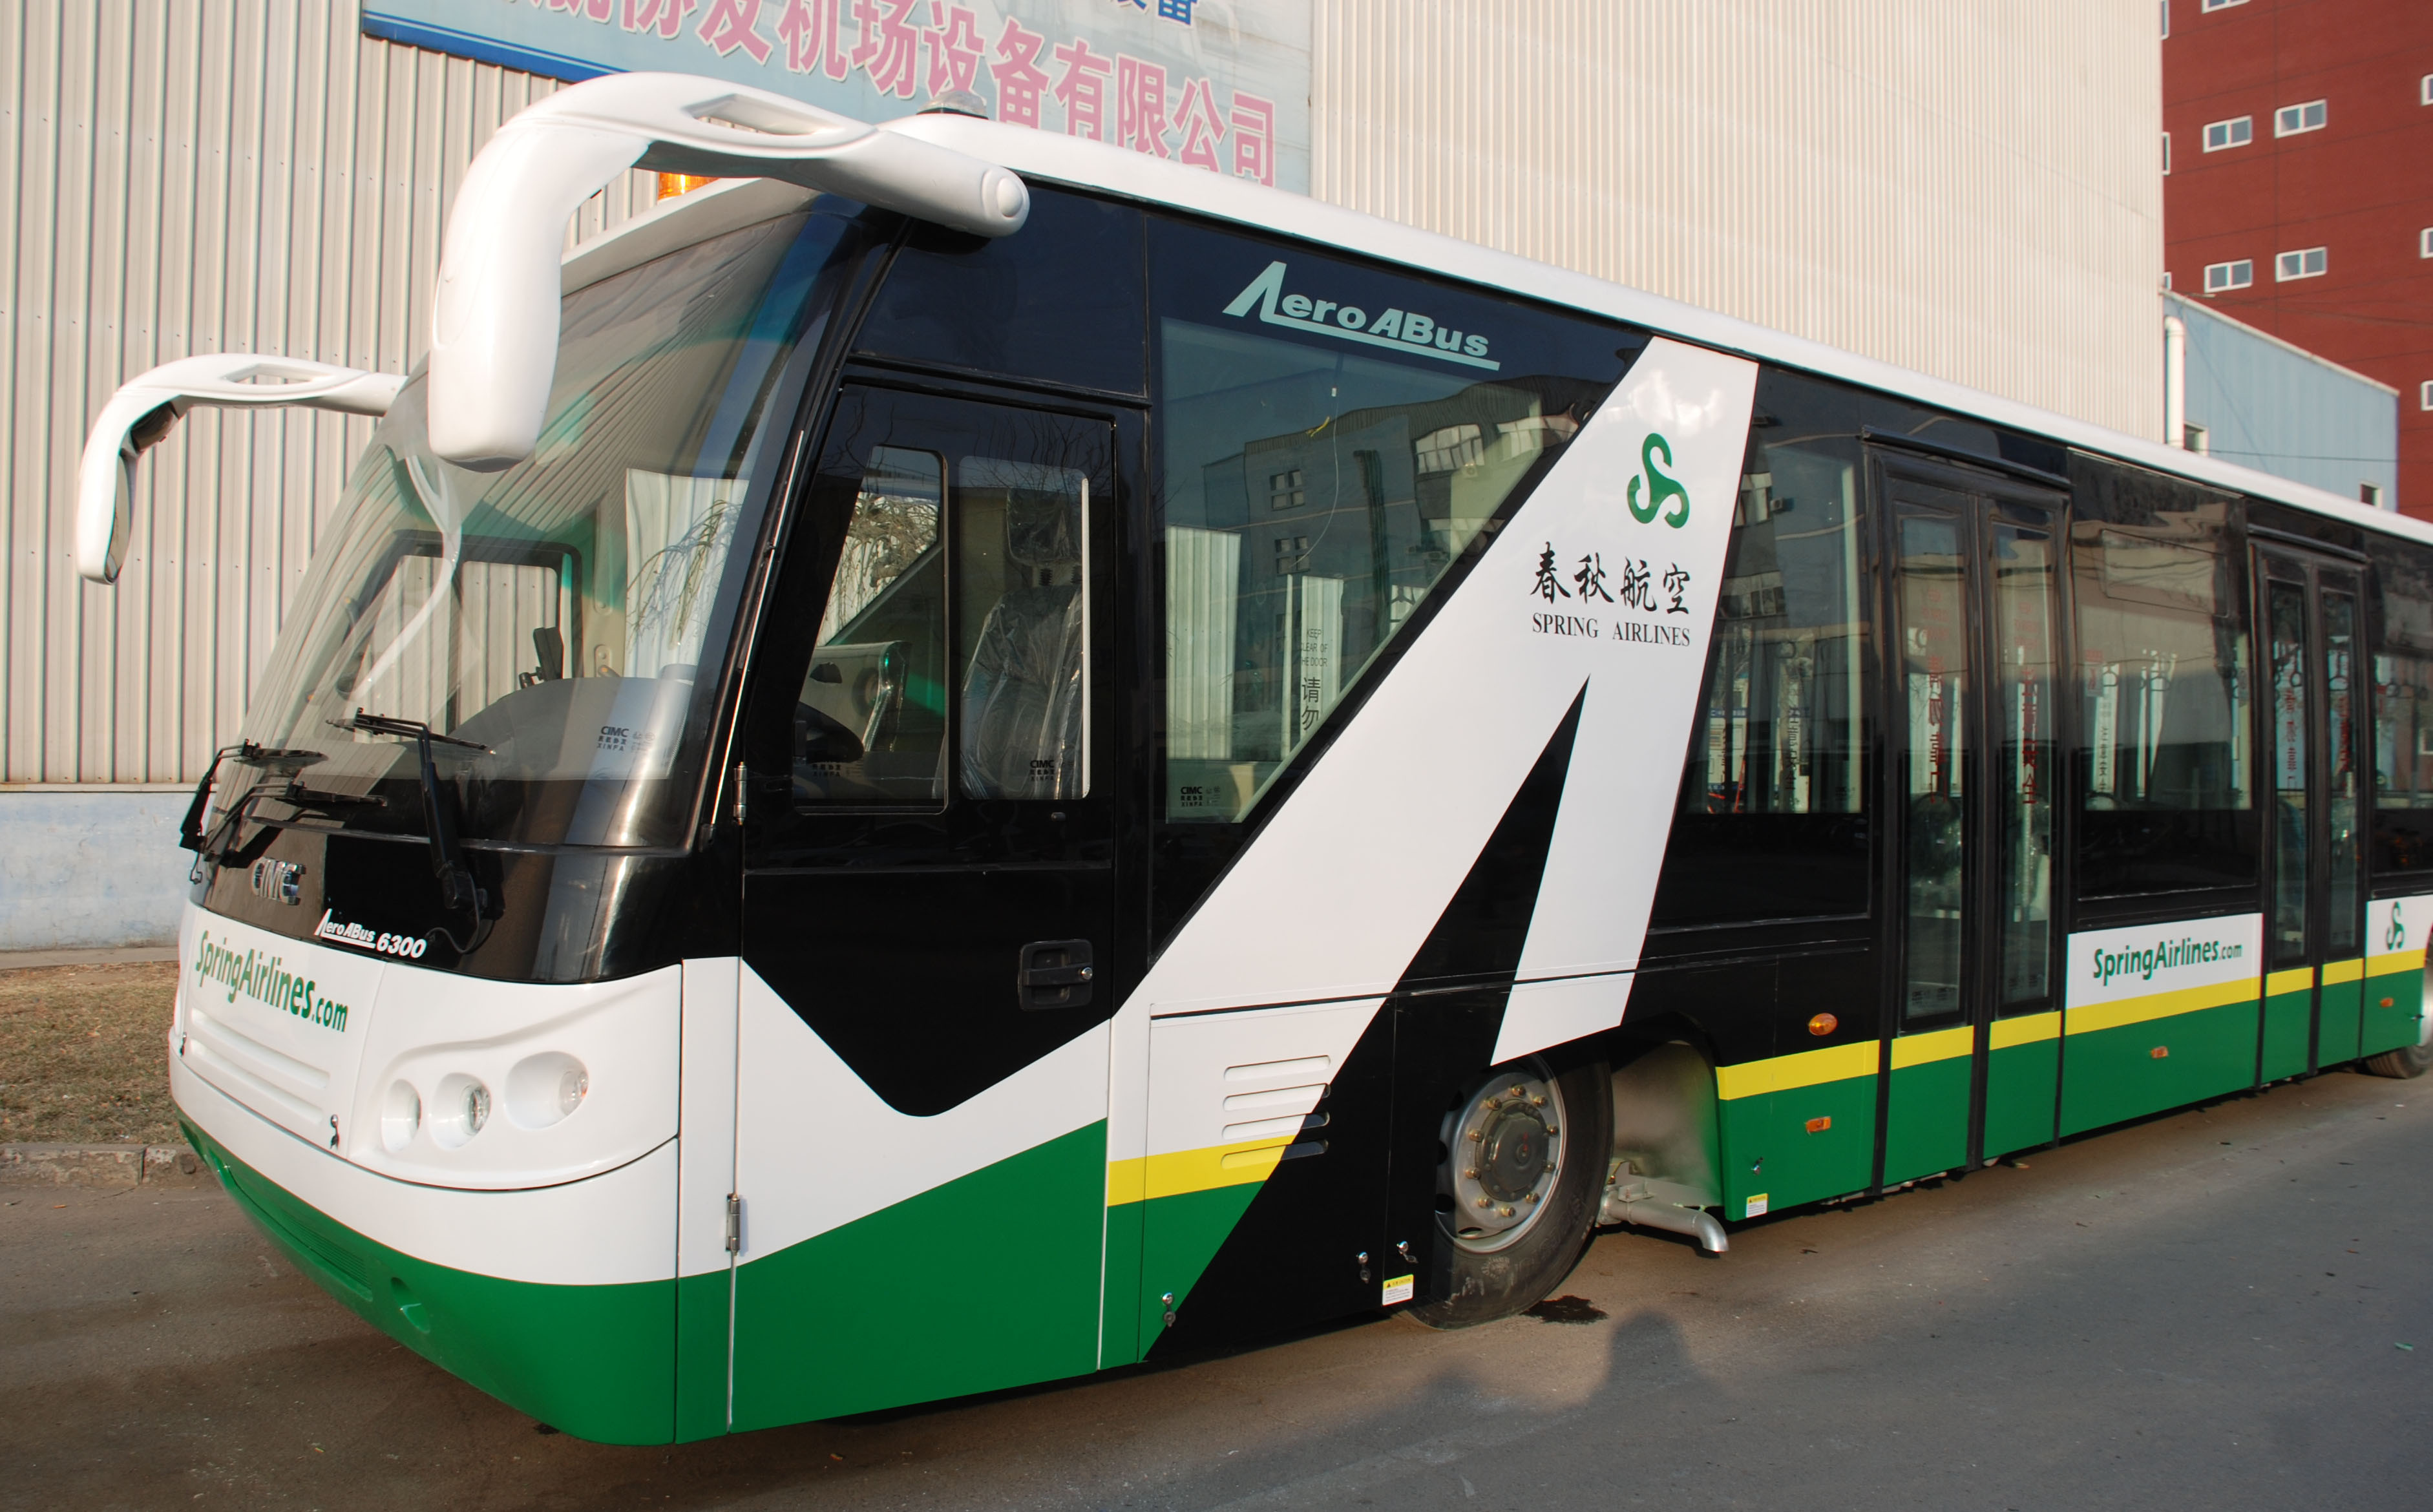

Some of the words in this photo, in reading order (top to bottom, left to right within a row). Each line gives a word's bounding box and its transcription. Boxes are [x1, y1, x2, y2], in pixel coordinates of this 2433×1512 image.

[1530, 541, 1690, 614] 春秋航空
[1532, 612, 1599, 638] SPRING
[1612, 621, 1690, 647] AIRLINES
[1301, 677, 1321, 731] 请勿
[600, 726, 629, 738] CIMC
[1030, 759, 1055, 768] CIMC
[1181, 786, 1203, 795] CIMC
[251, 856, 306, 905] CIMC
[376, 932, 428, 958] 6300
[2093, 937, 2242, 987] SpringAirlines.com
[195, 930, 348, 1033] SpringAirlines.com
